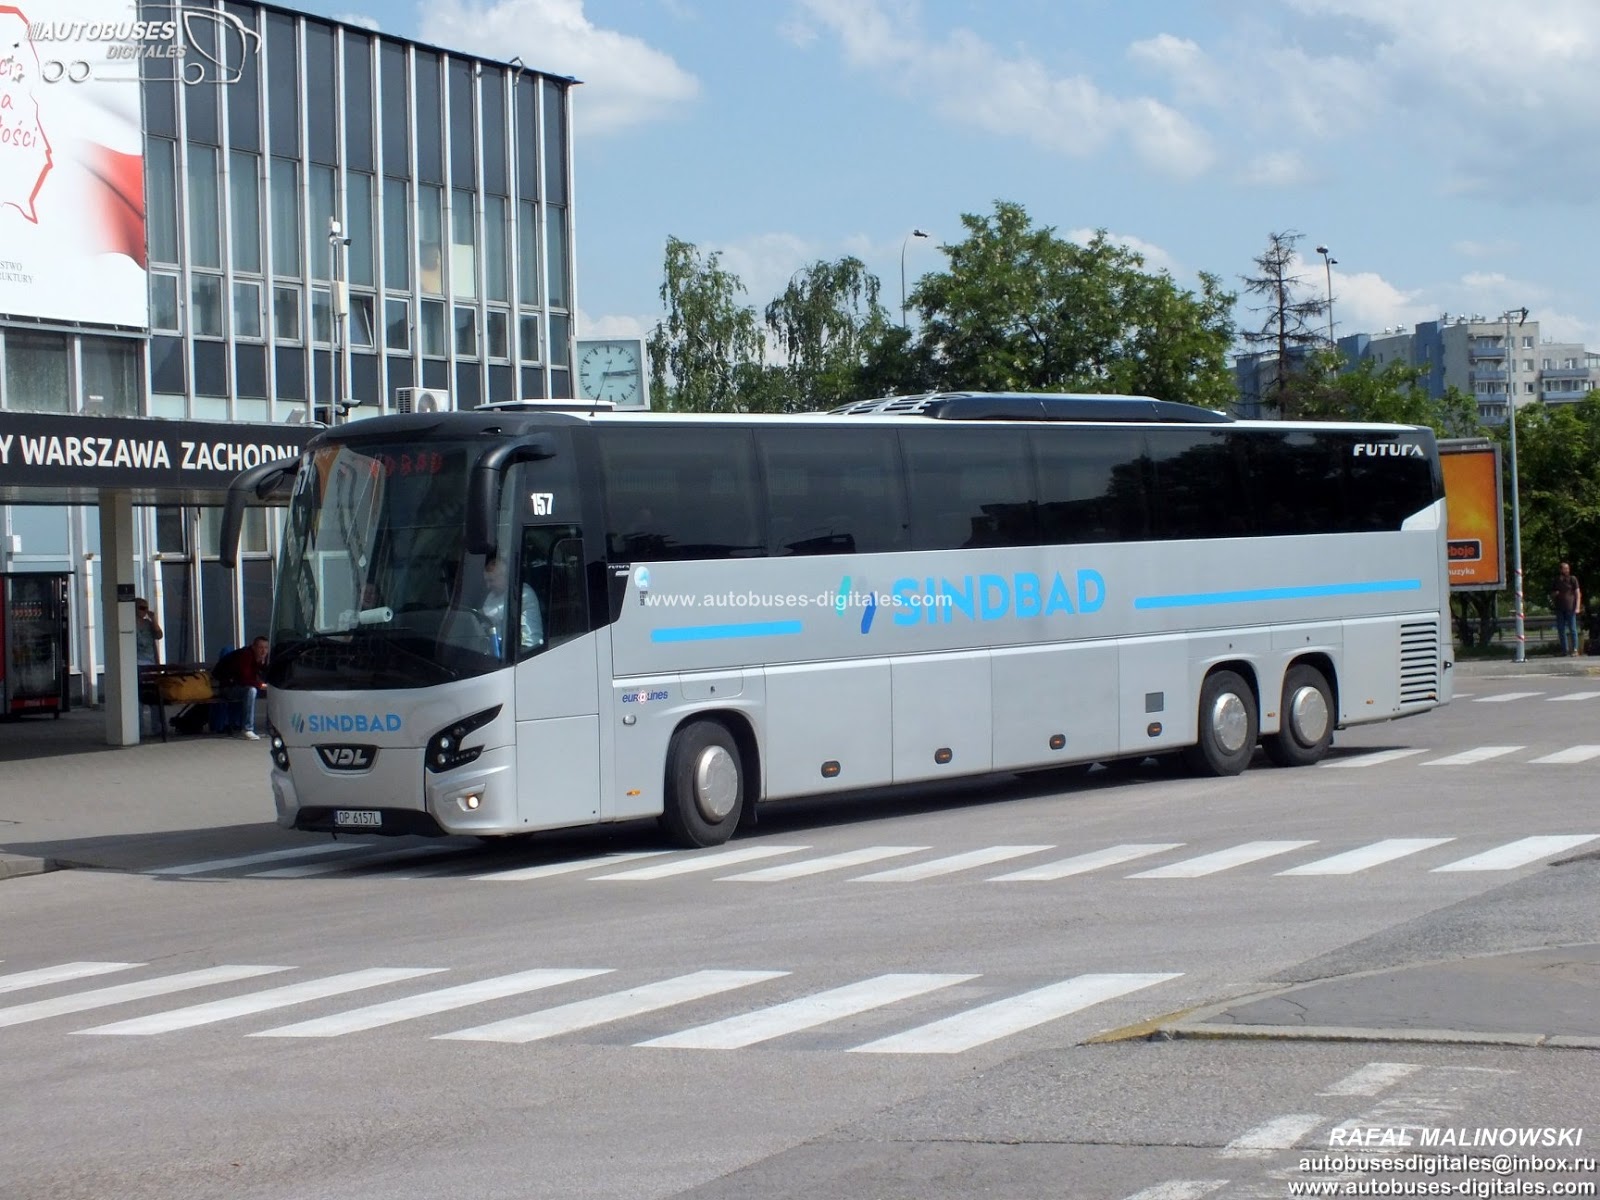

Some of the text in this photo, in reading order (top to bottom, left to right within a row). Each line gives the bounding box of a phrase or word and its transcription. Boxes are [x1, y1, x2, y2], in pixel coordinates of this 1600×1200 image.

[0, 272, 33, 284] UKTURY
[20, 435, 171, 469] WARSZAWA
[1353, 443, 1424, 456] FUTURA
[531, 493, 553, 515] 157
[1449, 567, 1475, 576] uzyka
[893, 568, 1106, 627] SINDBAD
[308, 714, 402, 732] SINDBAD
[324, 749, 368, 765] VDL
[339, 812, 380, 825] OP 6157L
